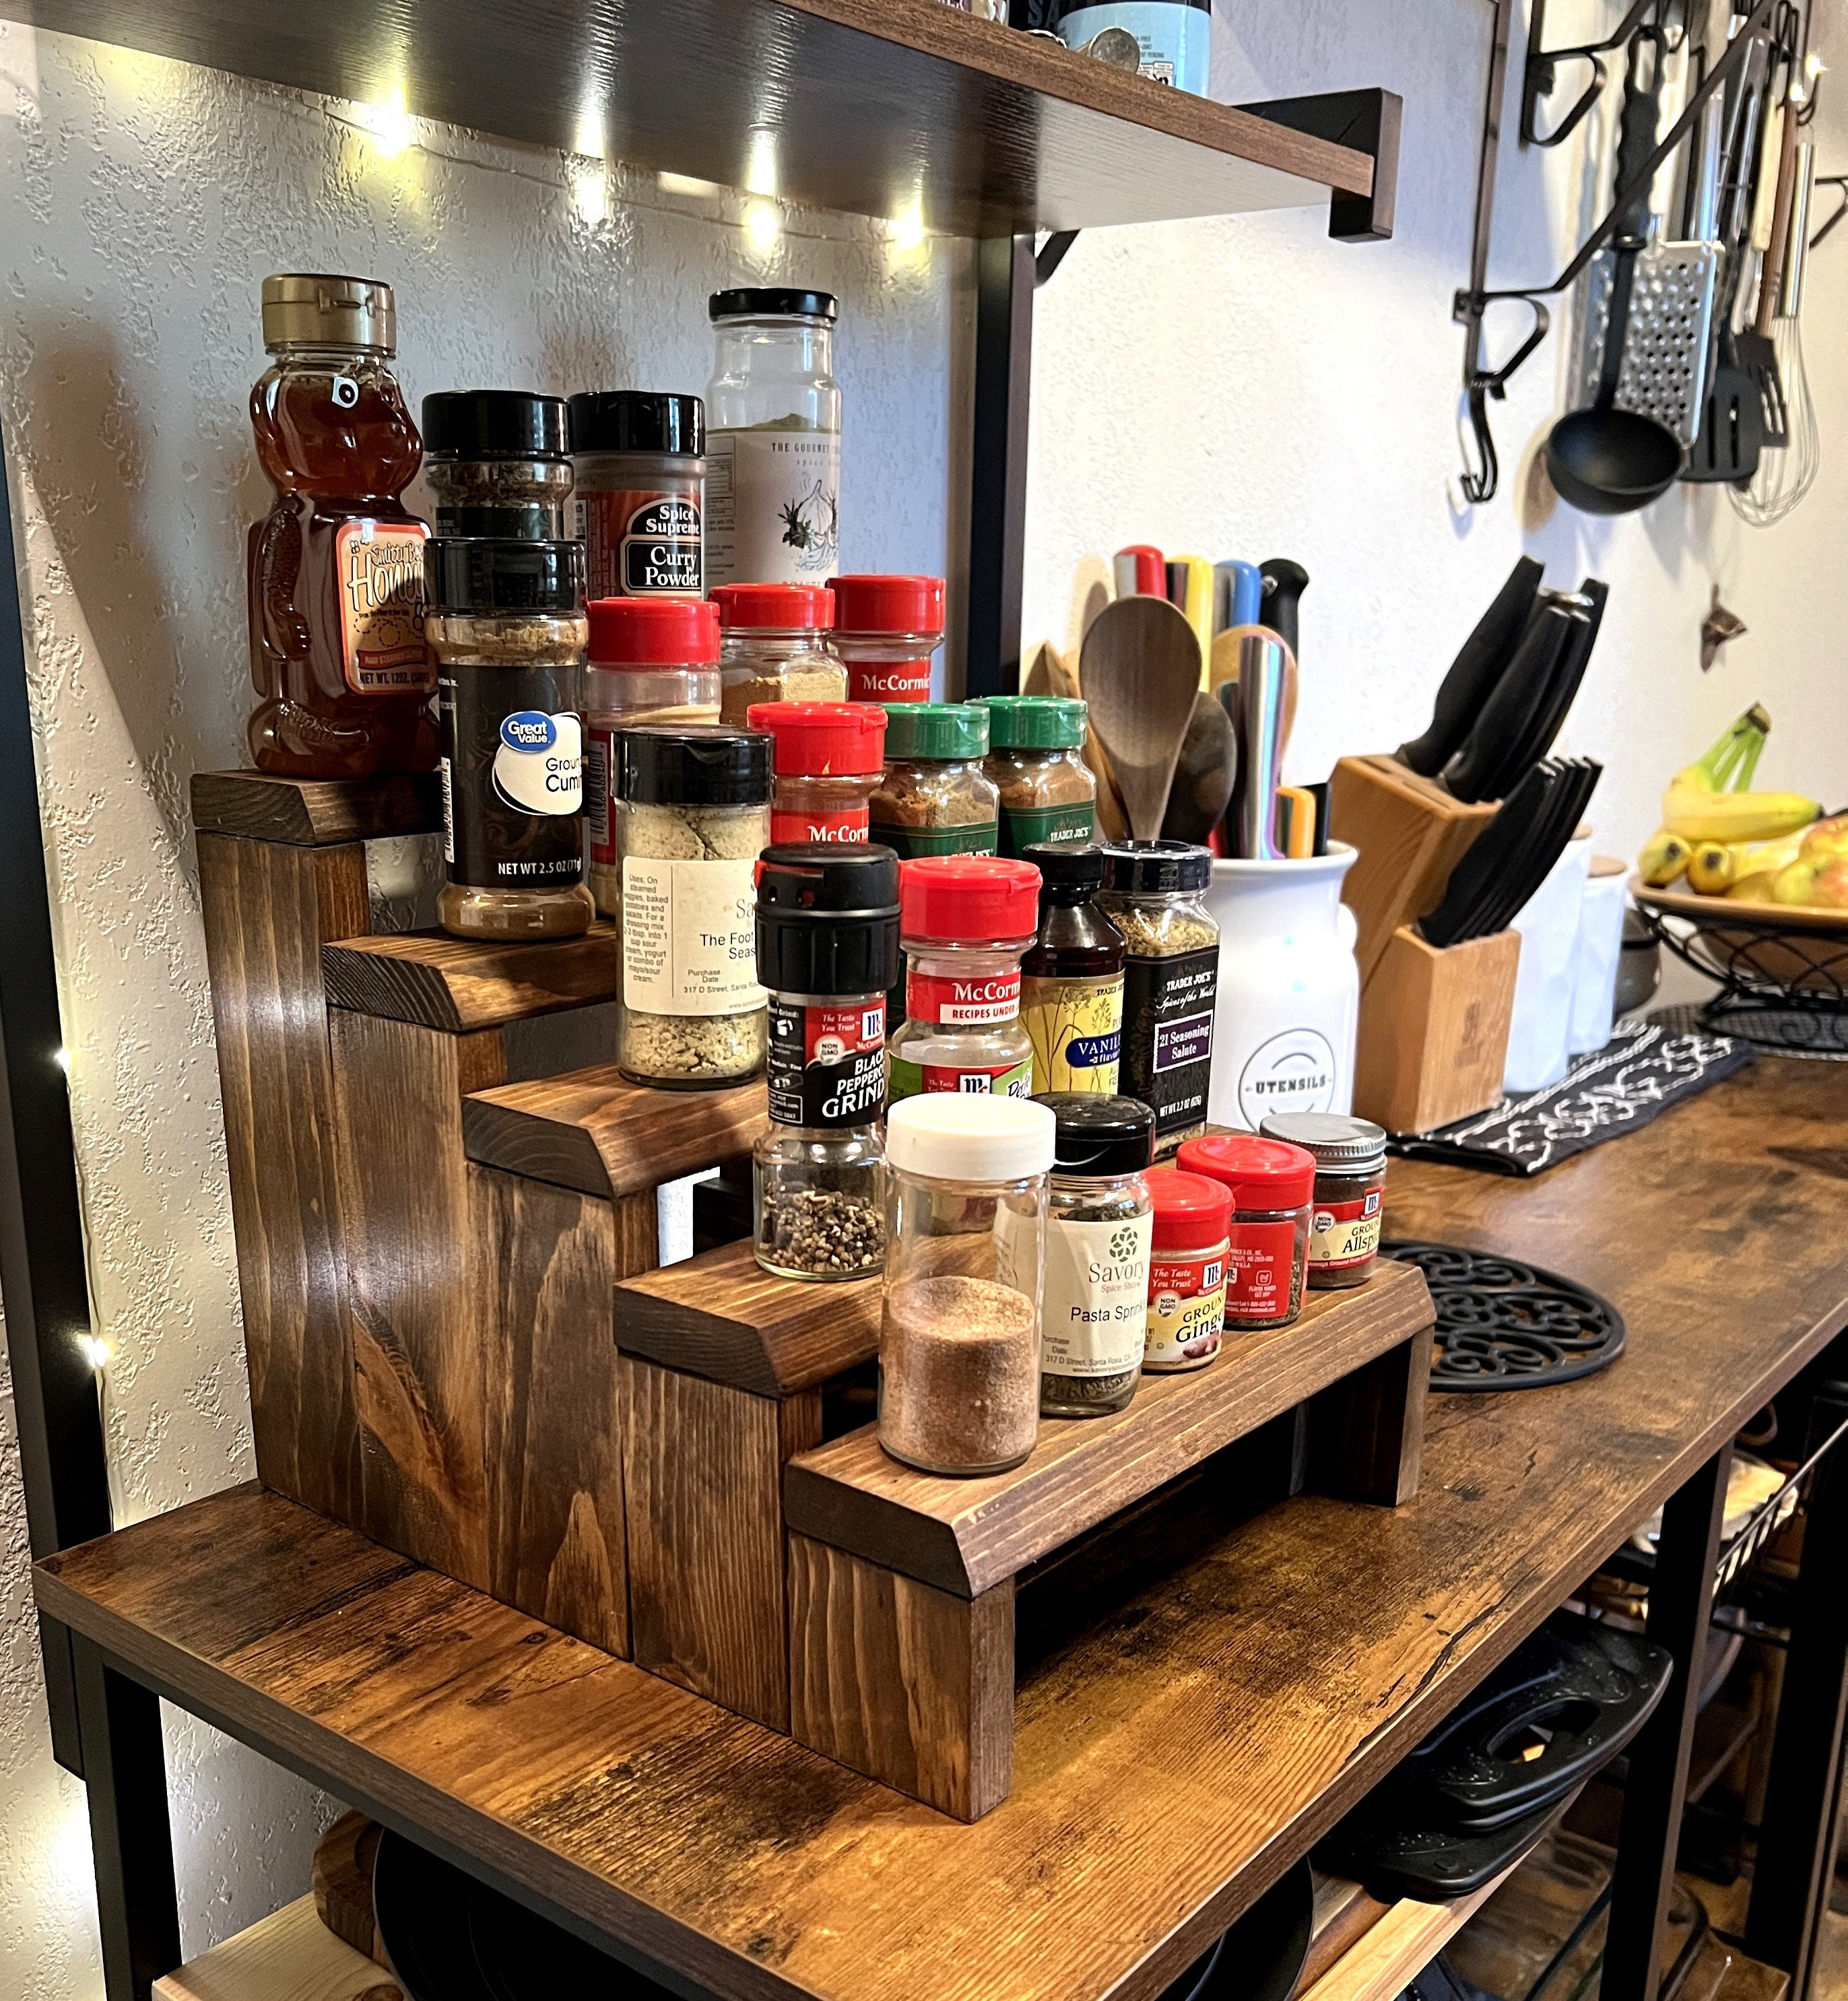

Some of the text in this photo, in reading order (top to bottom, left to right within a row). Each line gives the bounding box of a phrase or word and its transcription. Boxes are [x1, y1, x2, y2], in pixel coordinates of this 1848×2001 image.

[772, 443, 789, 452] THE
[659, 506, 694, 523] Spice
[646, 519, 700, 536] Supreme
[651, 546, 697, 572] Curry
[347, 551, 425, 612] Honey
[645, 566, 700, 587] Powder
[359, 672, 374, 684] NET
[507, 721, 548, 737] Great
[518, 731, 549, 744] Value
[1050, 829, 1074, 843] TRADER
[498, 863, 519, 875] NET
[520, 863, 537, 874] WT
[539, 862, 554, 874] 2.5
[556, 861, 566, 872] OZ
[647, 876, 658, 884] On
[647, 895, 669, 904] baked
[700, 933, 726, 947] The
[645, 950, 666, 958] yogurt
[1166, 971, 1212, 992] TRADER JOE'S
[823, 1014, 855, 1022] The Taste
[952, 1009, 991, 1019] RECIPES
[993, 1004, 1015, 1017] UNDER
[822, 1024, 835, 1032] You
[1159, 1024, 1210, 1048] 21 Seasoning
[1171, 1043, 1197, 1060] Salute
[1255, 1074, 1327, 1095] UTENSILS
[1088, 1260, 1144, 1284] Savory
[1154, 1268, 1191, 1278] The Taste
[1101, 1284, 1122, 1294] Spice
[1152, 1278, 1191, 1288] You Trust
[1071, 1306, 1111, 1323] Pasta
[1052, 1346, 1067, 1354] Date
[1046, 1354, 1058, 1363] 317
